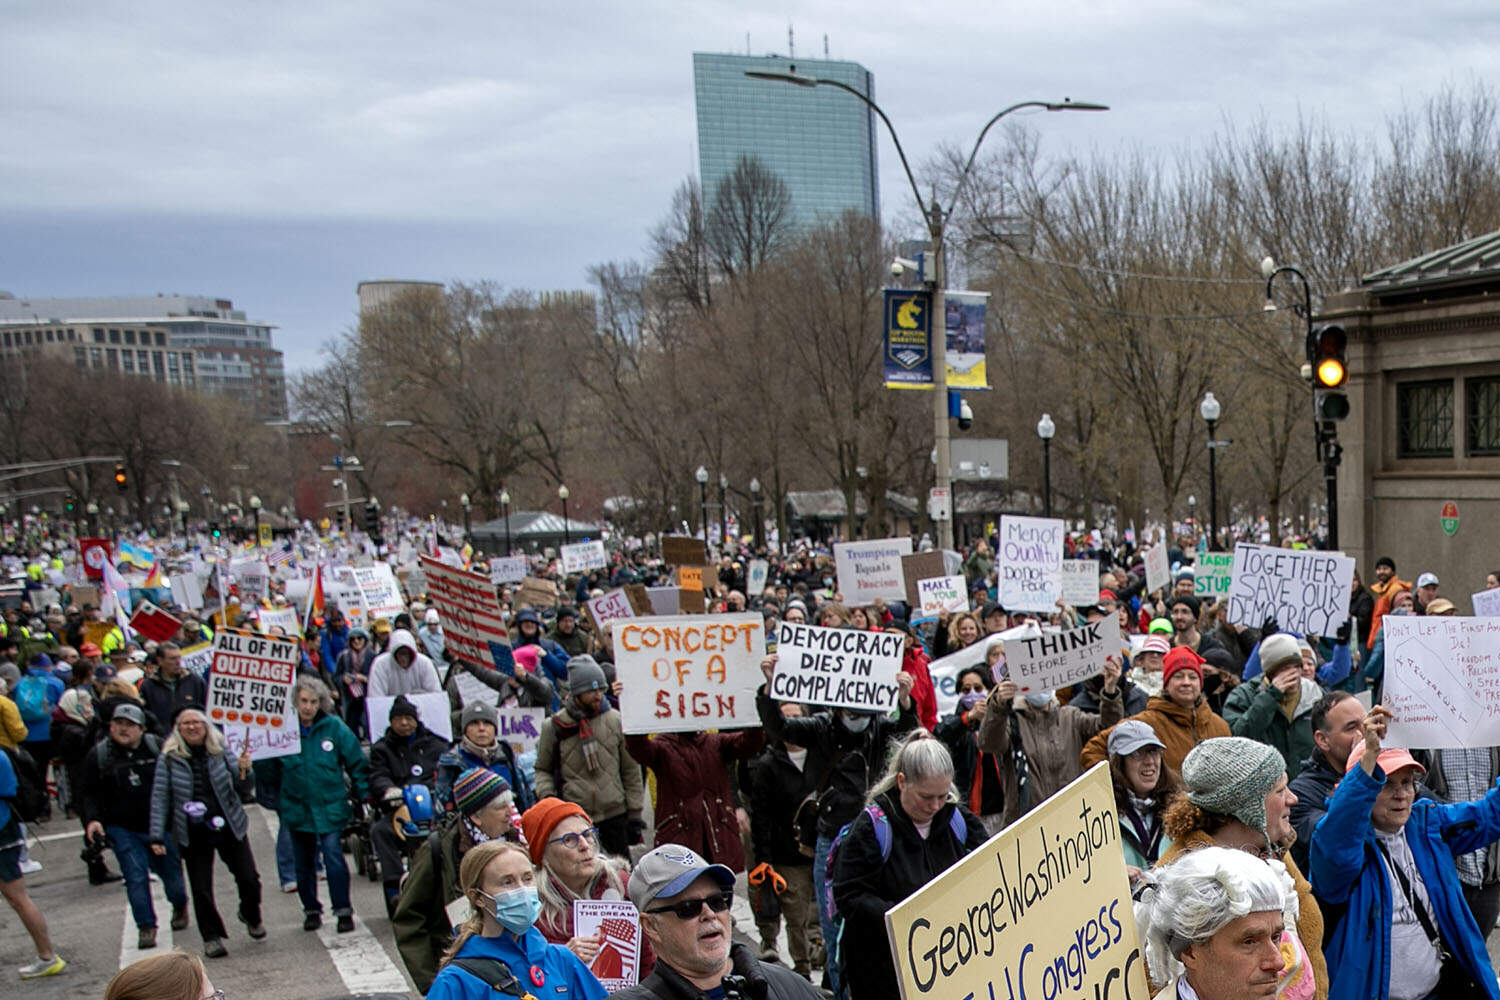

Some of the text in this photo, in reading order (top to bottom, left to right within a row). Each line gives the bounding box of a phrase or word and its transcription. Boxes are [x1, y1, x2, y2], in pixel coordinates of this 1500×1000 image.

[1008, 524, 1058, 544] Men of
[845, 549, 900, 561] Trumpism
[1004, 542, 1059, 573] Quality
[1199, 553, 1233, 566] TARIF
[1238, 545, 1337, 584] TOGETHER
[855, 563, 892, 574] Equals
[857, 579, 899, 589] Fascism
[922, 578, 953, 592] MAKE
[932, 590, 958, 599] YOUR
[1195, 576, 1231, 594] STUP
[1236, 573, 1292, 605] SAVE
[594, 593, 620, 614] CUT
[1228, 596, 1335, 638] DEMOCRACY
[218, 636, 294, 659] ALL OF MY
[621, 623, 760, 653] CONCEPT
[780, 624, 904, 658] DEMOCRACY
[1021, 622, 1104, 659] THINK
[216, 654, 292, 682] OUTRAGE
[652, 654, 726, 686] OF A
[801, 653, 872, 677] DIES IN
[1020, 655, 1068, 677] BEFORE
[1039, 662, 1100, 690] ILLEGAL
[214, 677, 288, 698] CAN'T FIT ON
[773, 672, 899, 708] COMPLACENCY
[213, 691, 285, 715] THIS SIGN
[655, 689, 735, 719] SIGN
[908, 798, 1116, 993] George Washington
